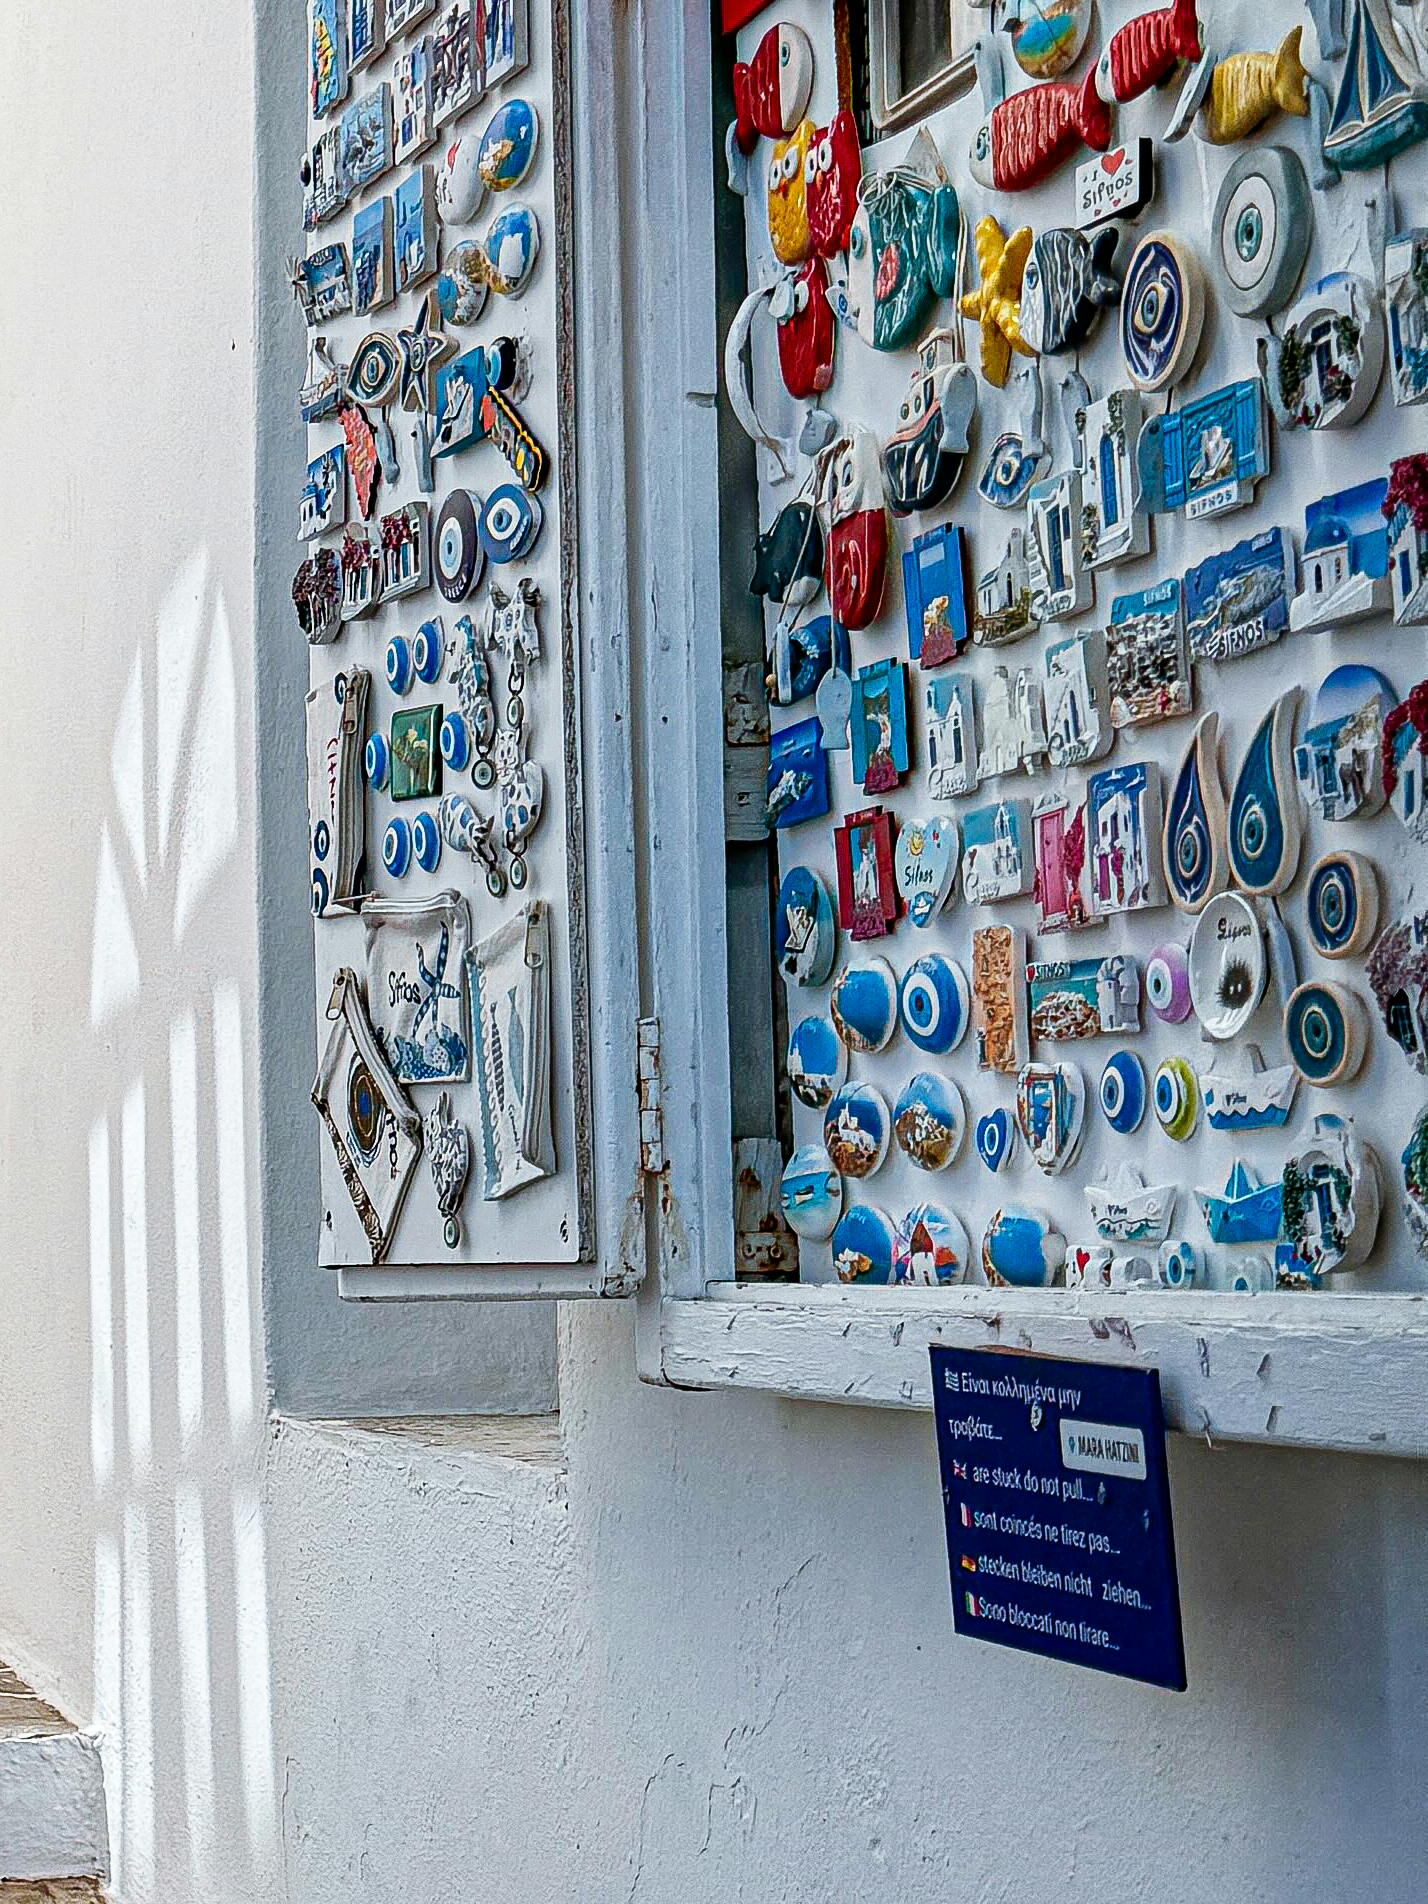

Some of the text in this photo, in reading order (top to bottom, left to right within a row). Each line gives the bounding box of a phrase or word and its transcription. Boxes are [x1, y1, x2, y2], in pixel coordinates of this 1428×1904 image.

[1059, 1388, 1081, 1411] μην
[973, 1466, 990, 1484] are
[992, 1466, 1022, 1490] stuck
[1024, 1469, 1039, 1493] do
[1041, 1476, 1060, 1496] not
[973, 1511, 997, 1531] sont
[1000, 1514, 1042, 1539] coincés
[1045, 1524, 1059, 1543] ne
[1061, 1524, 1085, 1549] tirez
[978, 1554, 1019, 1581] stecken
[1021, 1559, 1062, 1591] bleiben
[1064, 1571, 1092, 1597] nicht
[979, 1596, 1006, 1623] Sono
[1055, 1619, 1077, 1641] non
